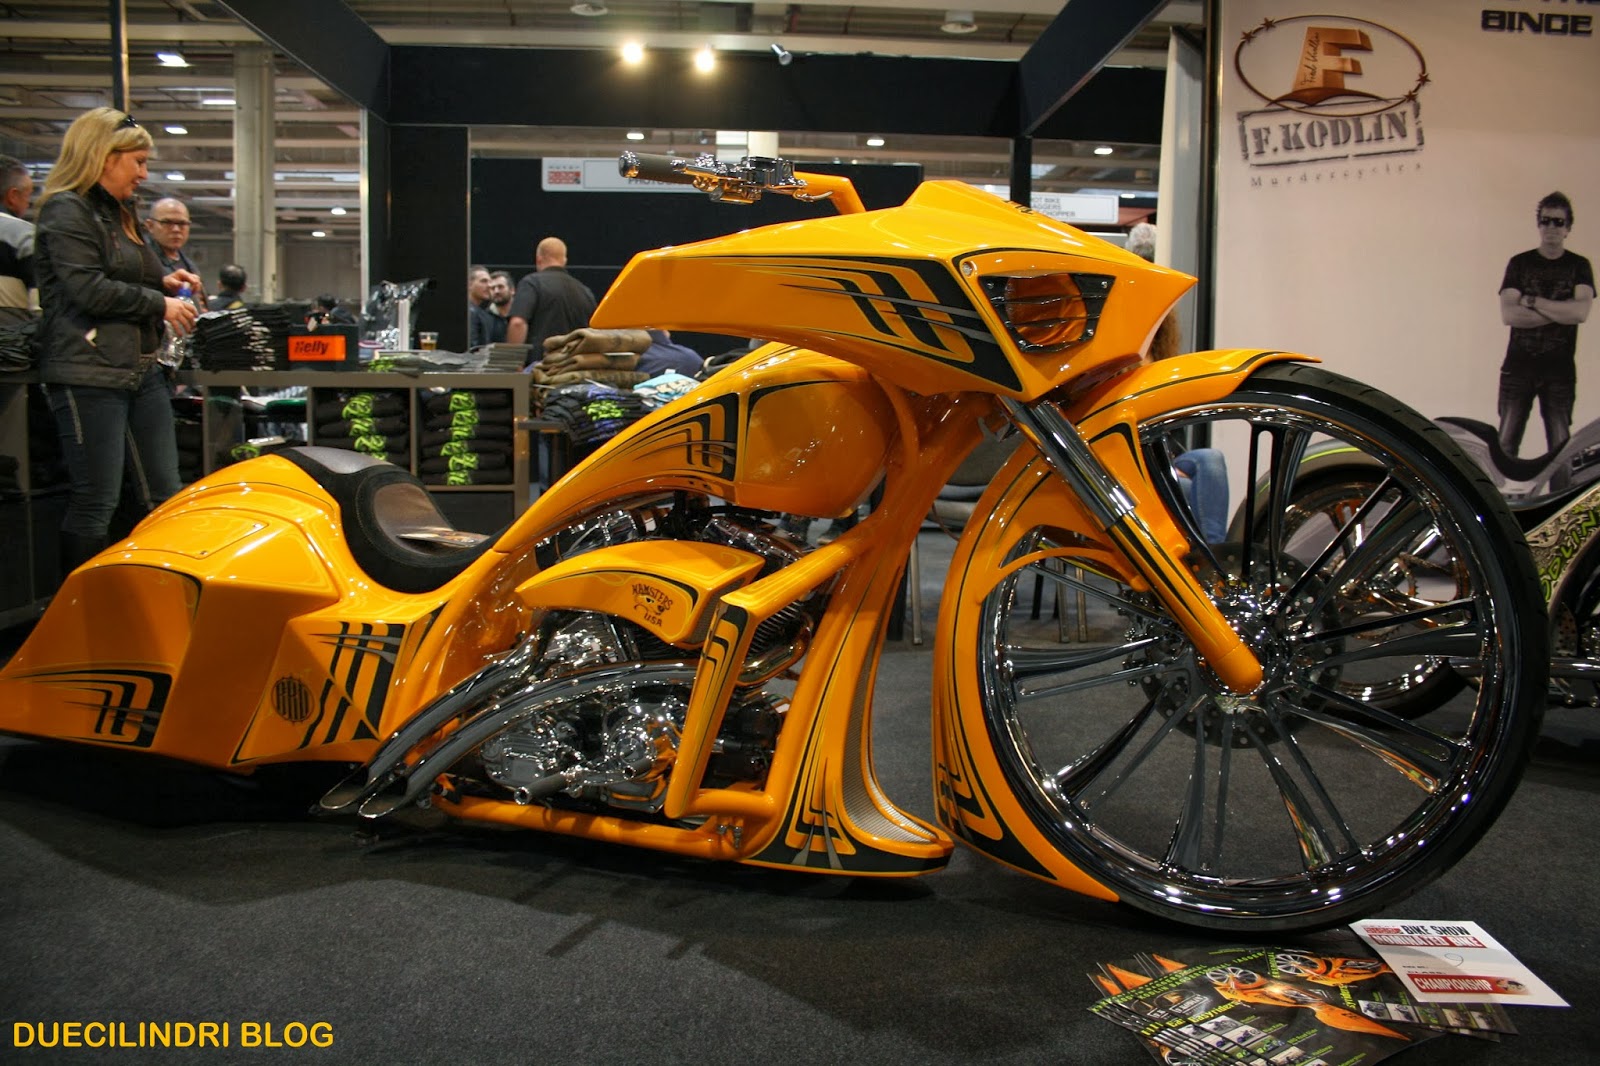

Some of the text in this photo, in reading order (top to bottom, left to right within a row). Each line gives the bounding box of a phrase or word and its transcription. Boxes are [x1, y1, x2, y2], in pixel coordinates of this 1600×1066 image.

[631, 583, 673, 611] HAMSTERS
[643, 612, 663, 627] USA
[1401, 925, 1430, 935] BIKE
[1431, 926, 1471, 935] SHOW
[1414, 977, 1493, 991] CHAMPIONSHIP
